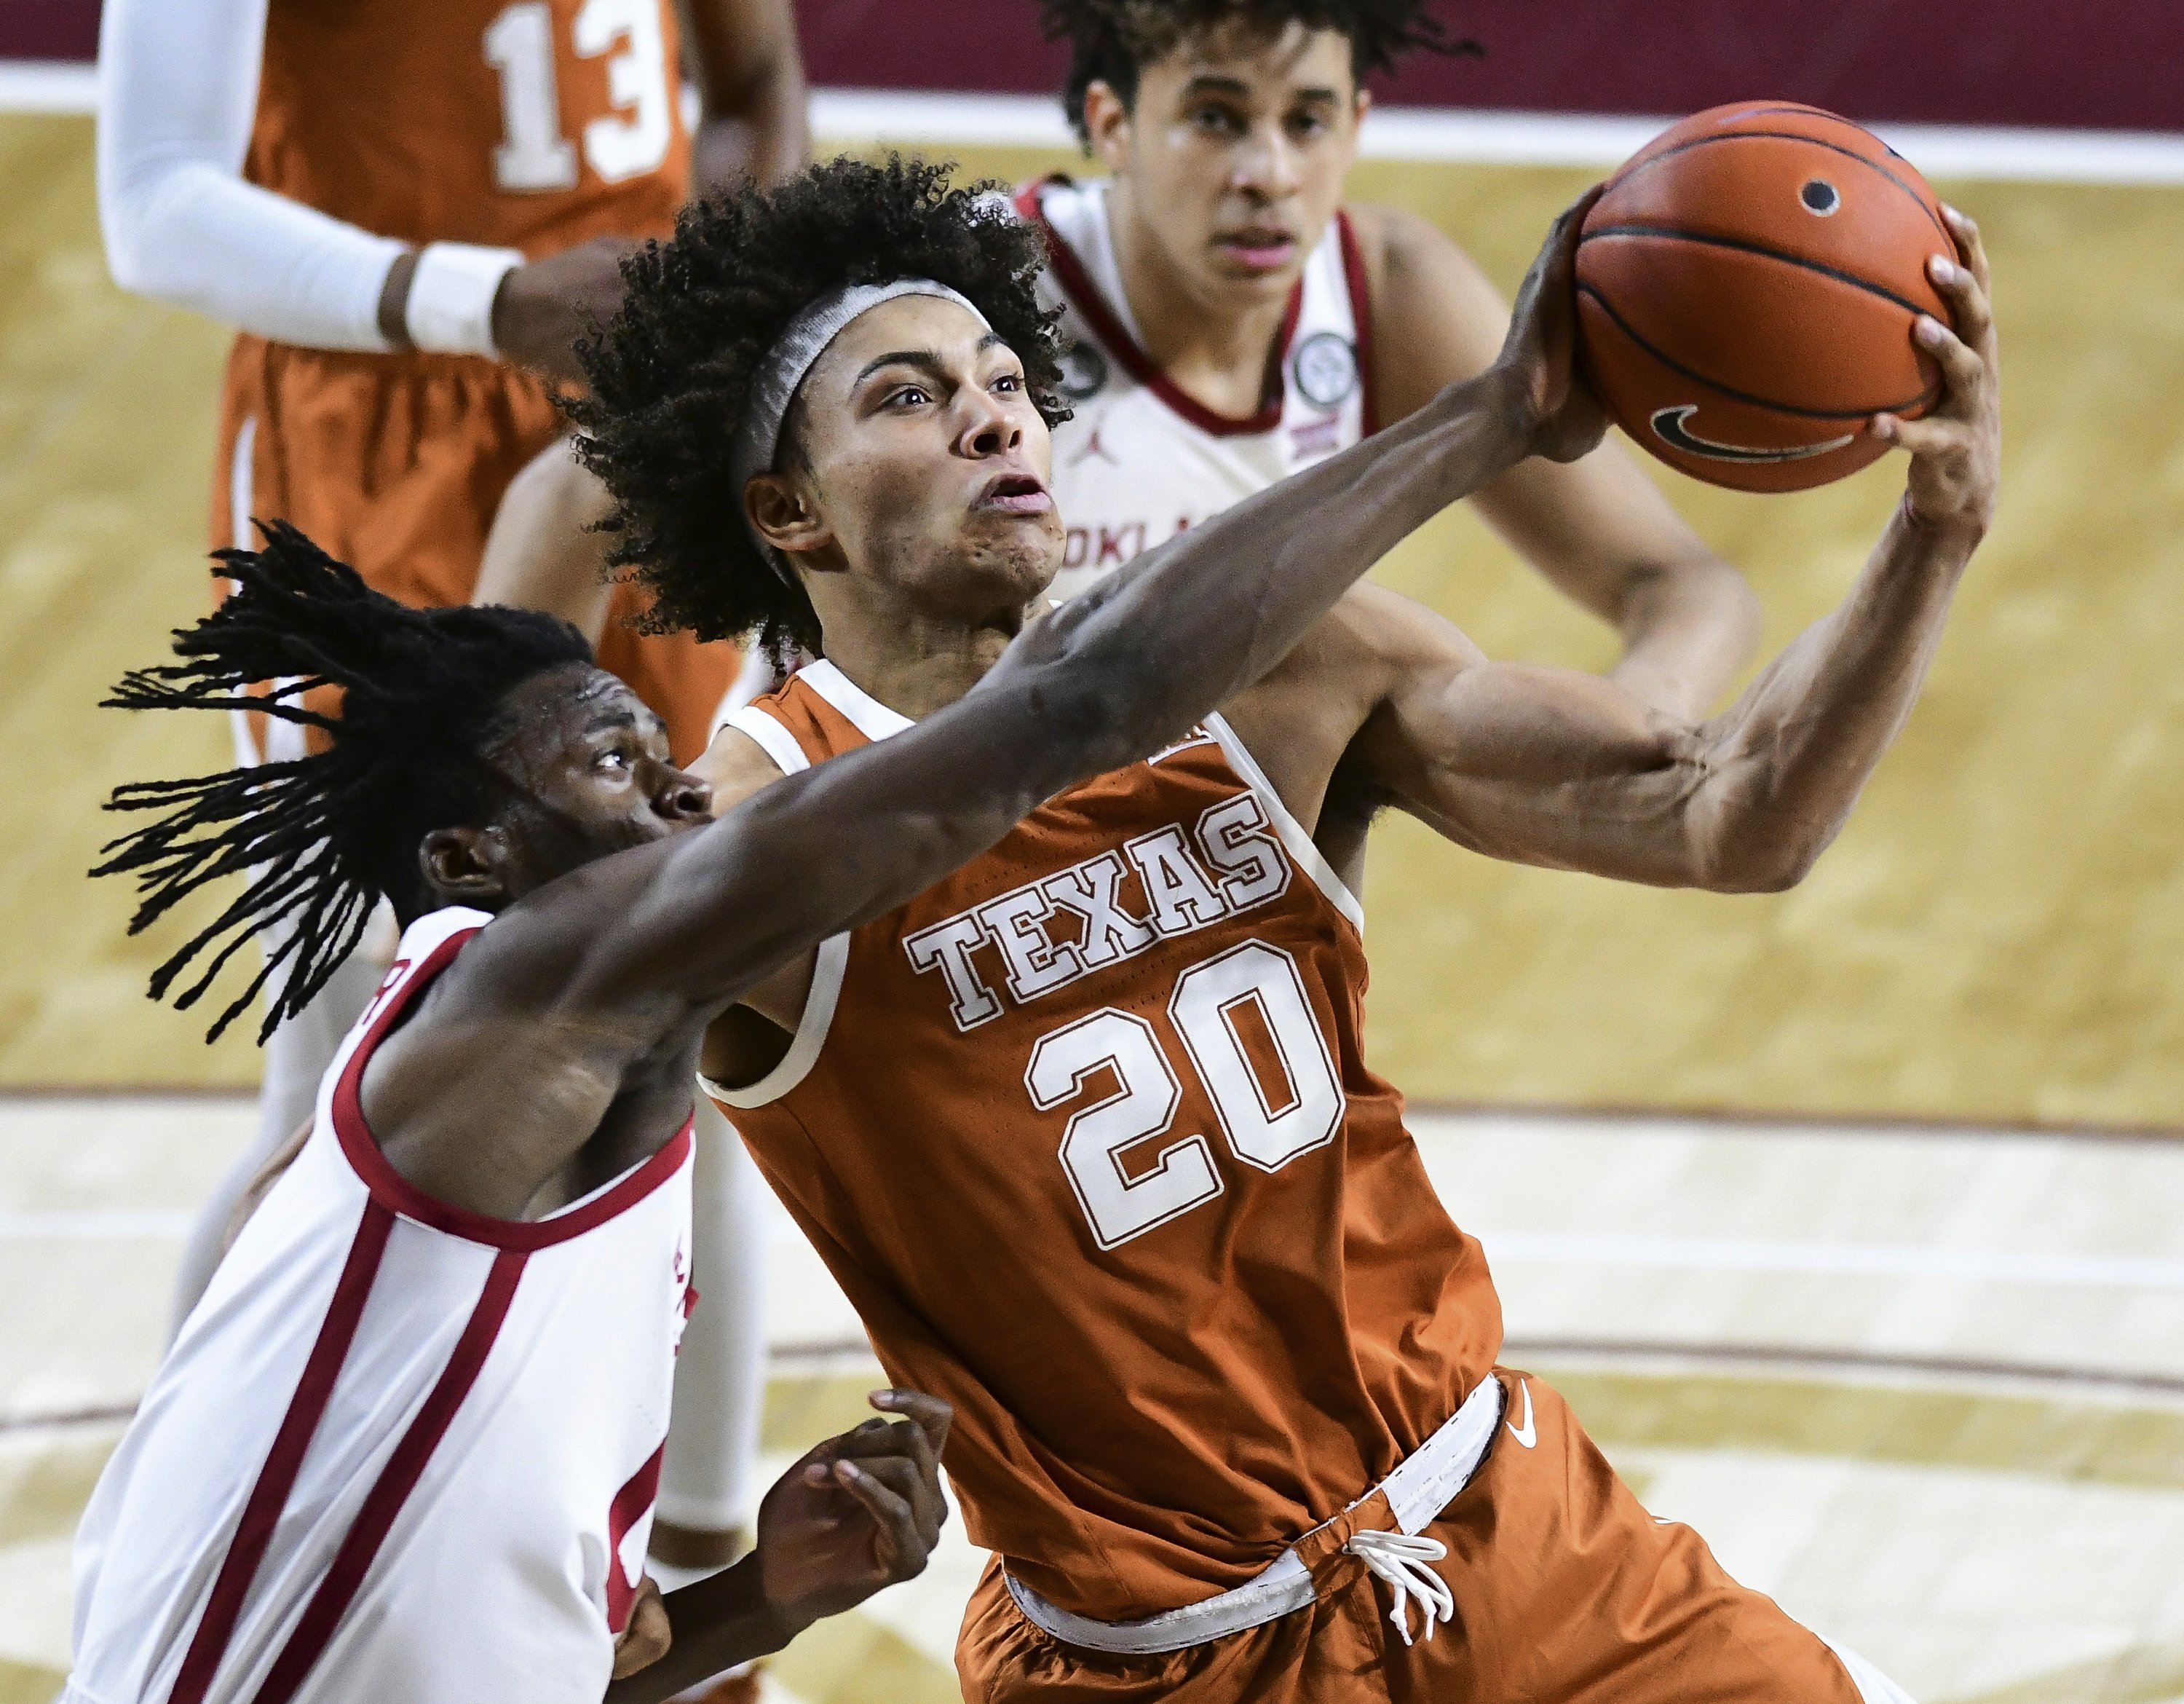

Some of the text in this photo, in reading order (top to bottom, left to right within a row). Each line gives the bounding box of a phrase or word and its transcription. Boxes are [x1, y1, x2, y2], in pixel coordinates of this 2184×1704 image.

[483, 0, 671, 192] 13
[902, 789, 1292, 1032] TEXAS
[1024, 938, 1345, 1250] 20
